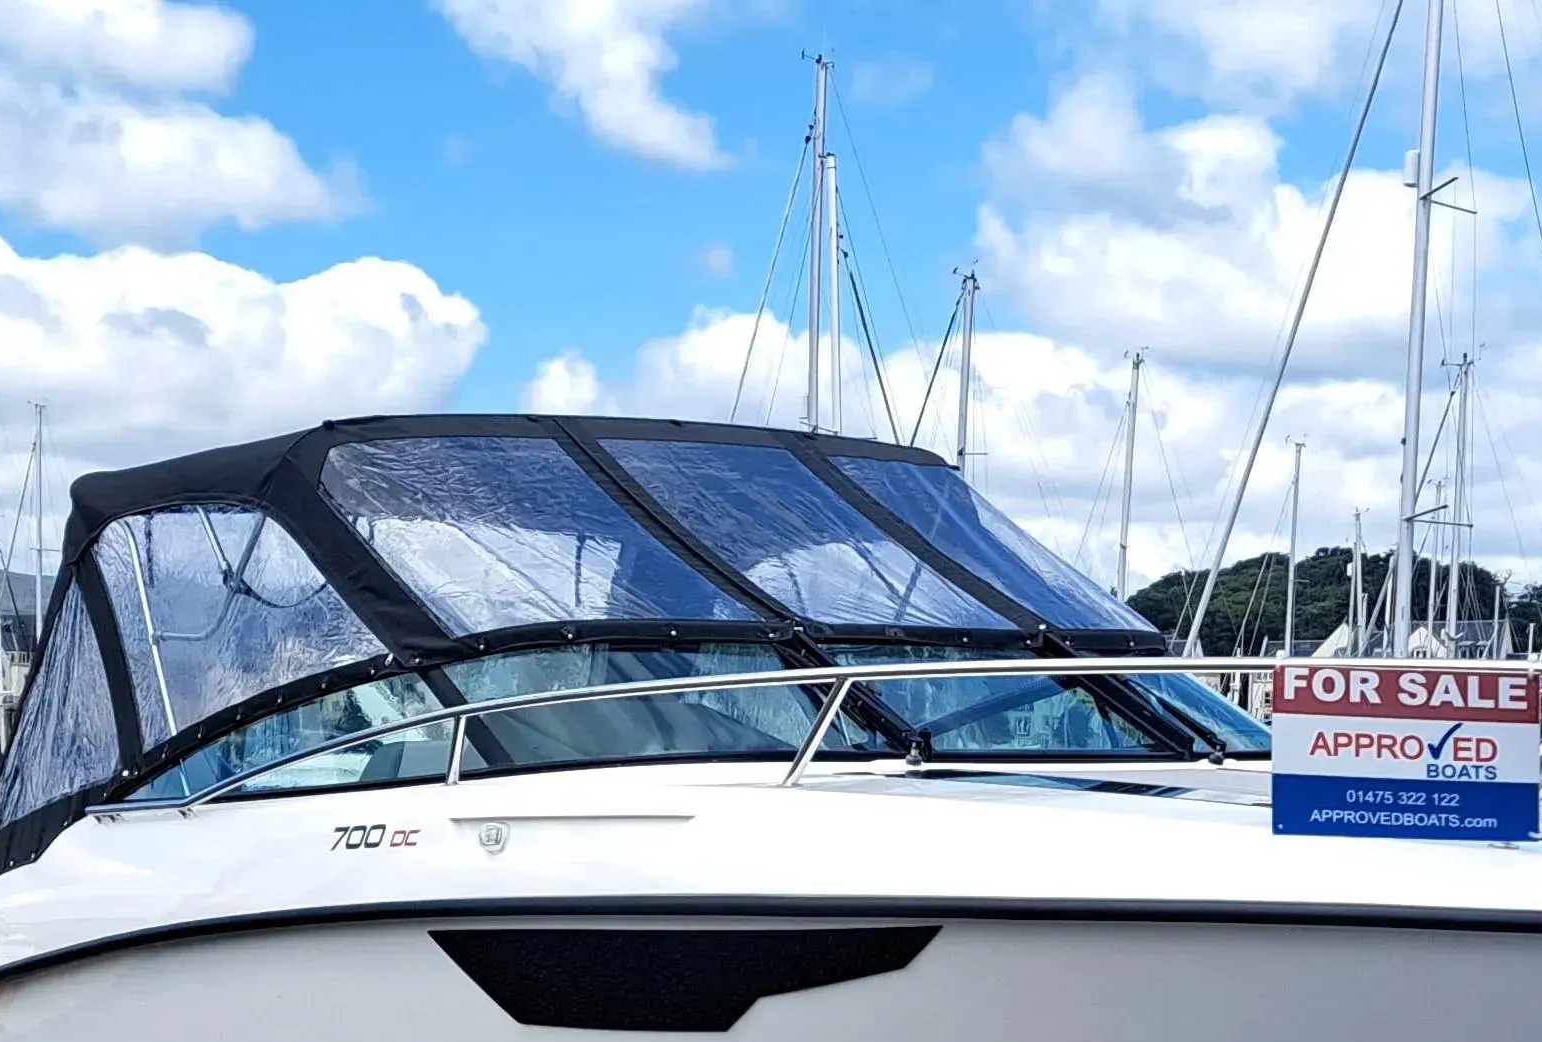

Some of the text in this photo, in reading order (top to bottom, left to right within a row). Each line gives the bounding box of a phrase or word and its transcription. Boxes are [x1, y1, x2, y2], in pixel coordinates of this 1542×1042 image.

[1283, 667, 1528, 710] FOR SALE
[1309, 723, 1498, 763] APPROVED
[1426, 763, 1498, 780] BOATS
[1346, 789, 1460, 807] 01475 322 122
[1309, 810, 1498, 828] APPROVEDBOATS.com
[330, 824, 421, 851] 700 DC
